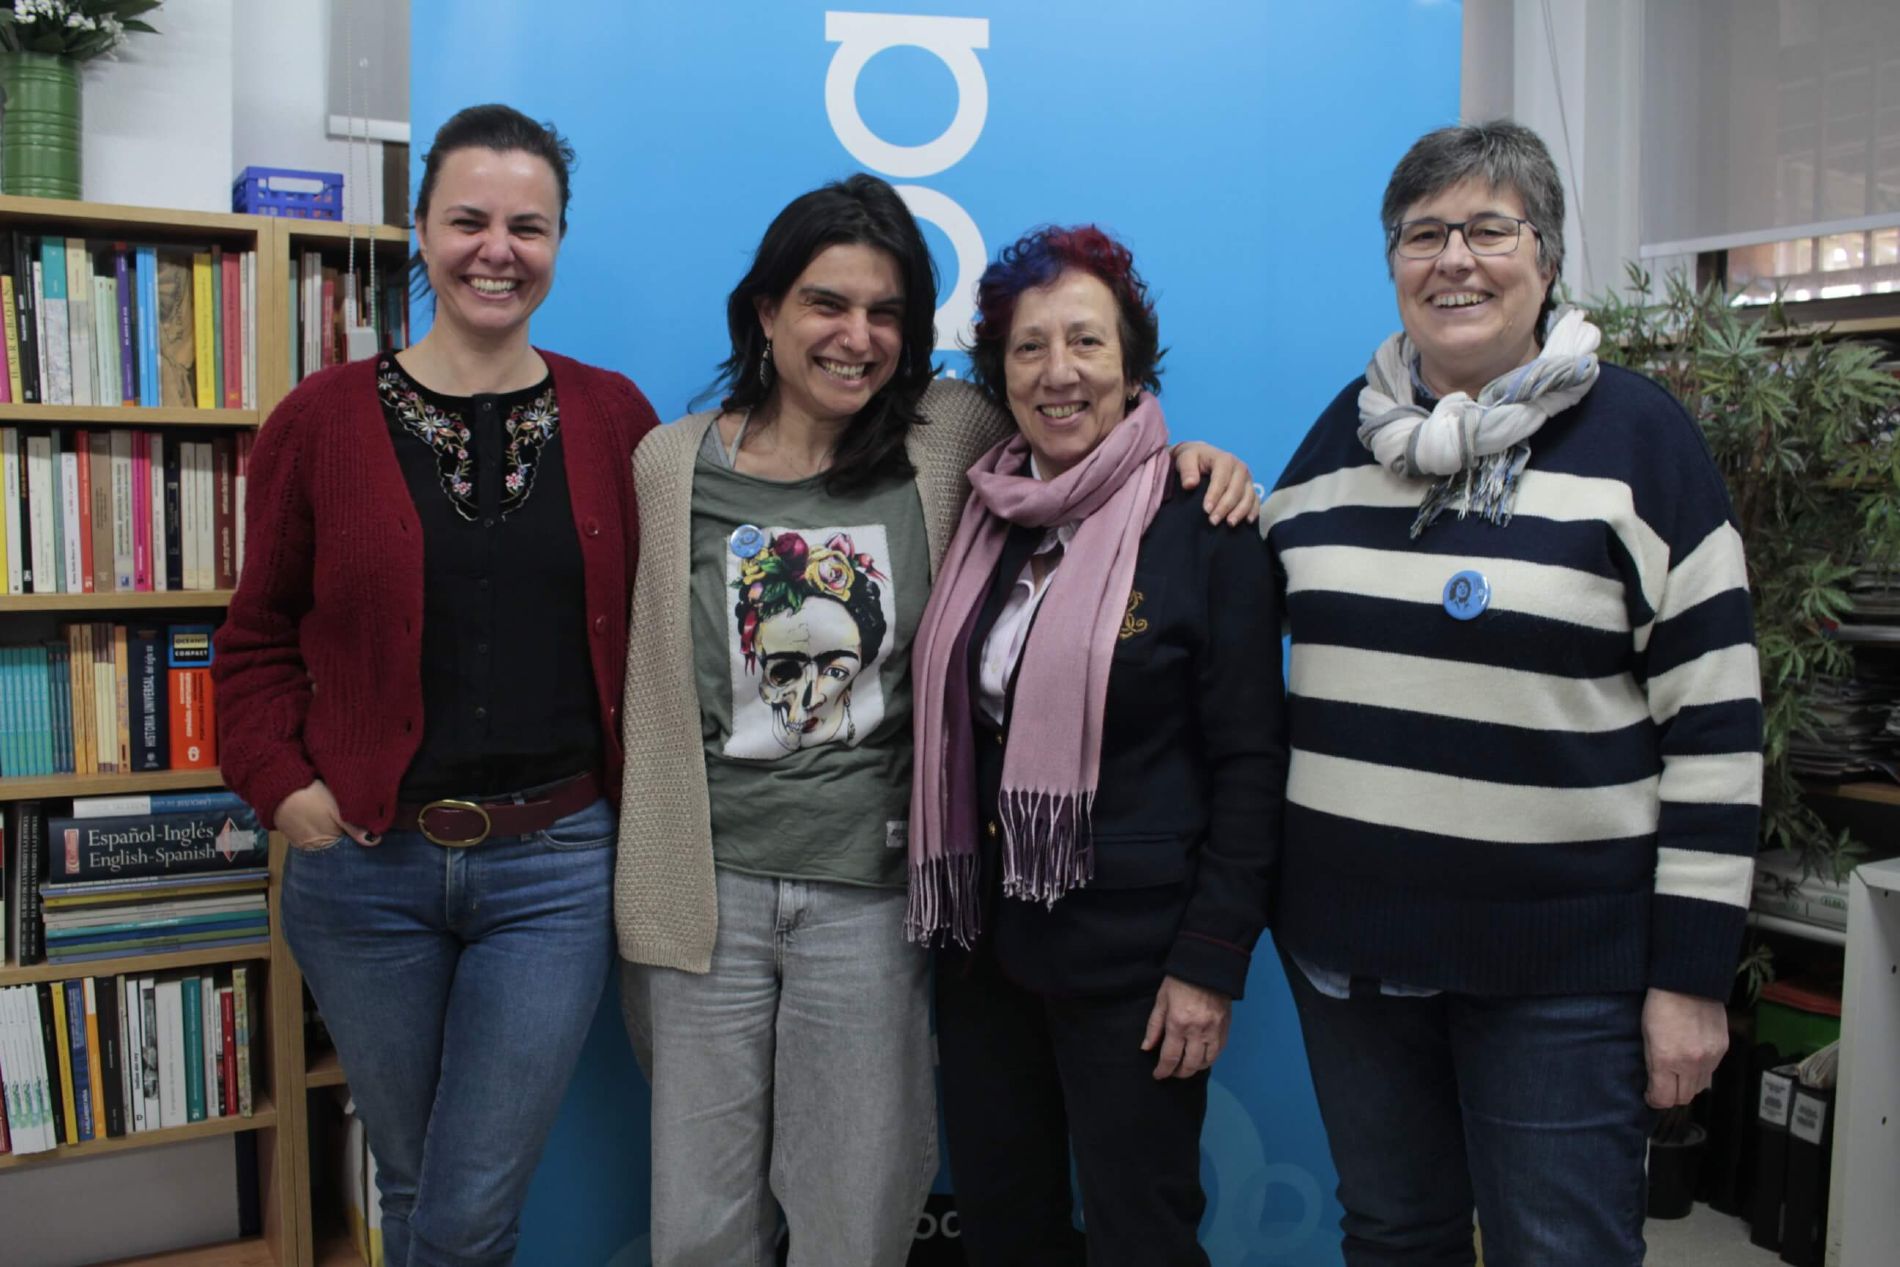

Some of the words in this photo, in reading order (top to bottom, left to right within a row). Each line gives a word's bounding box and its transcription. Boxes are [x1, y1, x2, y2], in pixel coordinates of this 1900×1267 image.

[143, 676, 155, 713] UNIVERSAL
[144, 714, 156, 747] HISTORIA
[88, 821, 214, 852] Español-Inglés
[89, 843, 216, 872] English-Spanish
